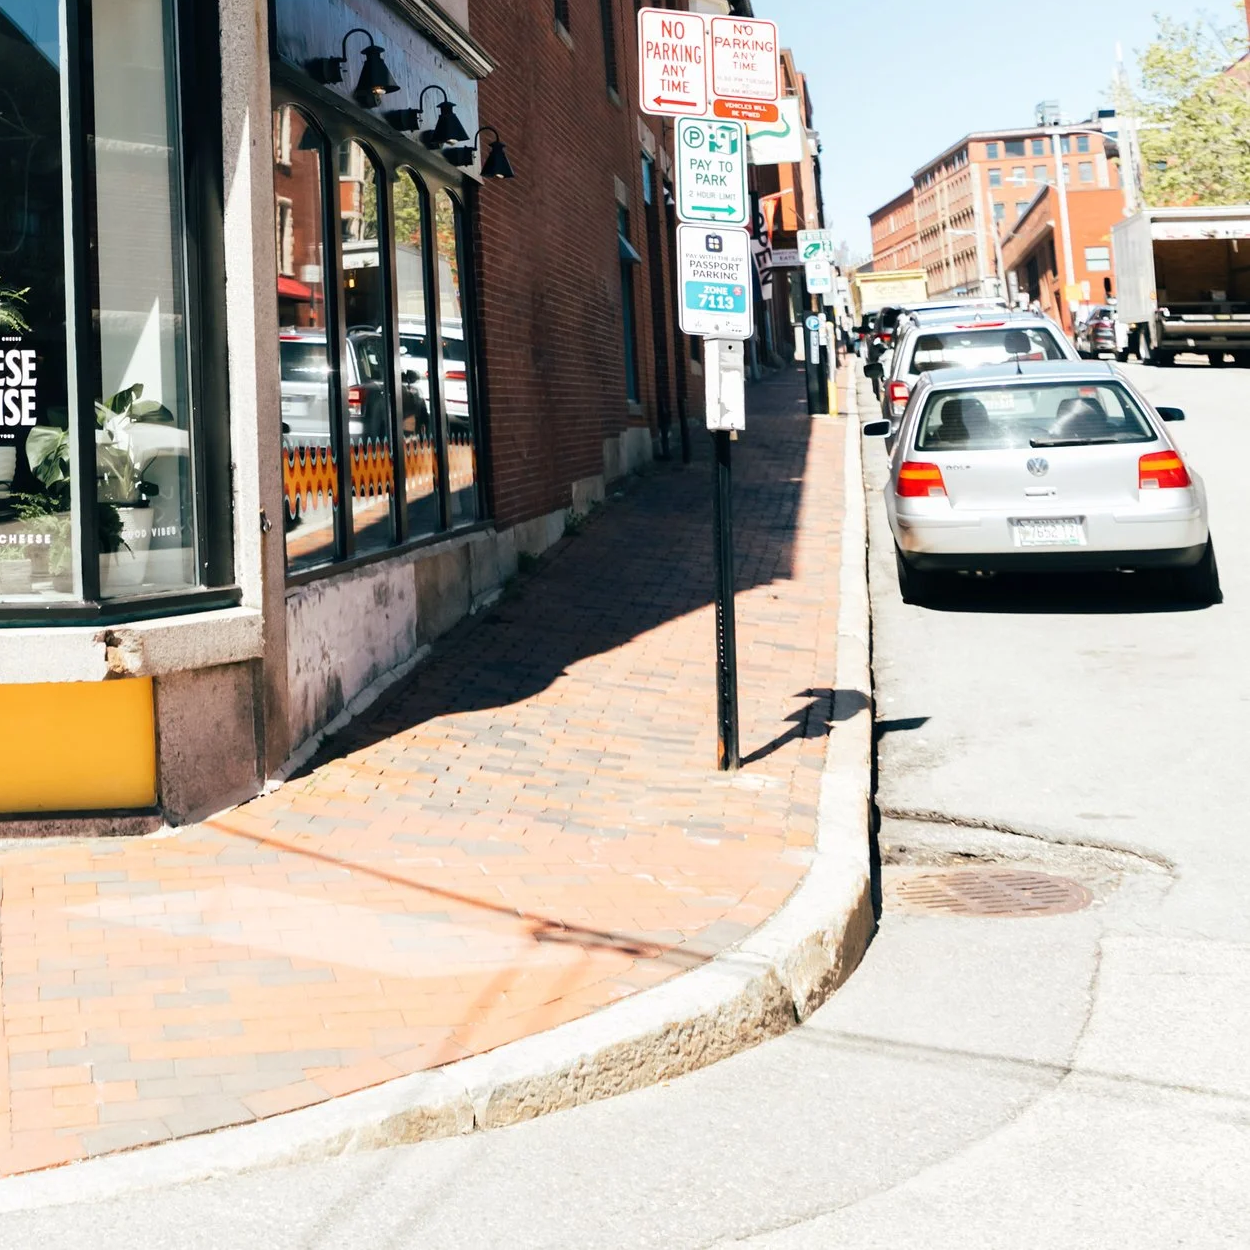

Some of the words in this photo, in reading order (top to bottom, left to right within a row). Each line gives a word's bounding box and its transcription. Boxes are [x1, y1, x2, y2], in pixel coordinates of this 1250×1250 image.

[661, 20, 685, 39] NO
[733, 24, 753, 36] NO
[715, 37, 773, 52] PARKING
[646, 41, 701, 64] PARKING
[733, 52, 756, 61] ANY
[662, 64, 686, 77] ANY
[733, 61, 757, 71] TIME
[660, 79, 690, 94] TIME
[690, 158, 712, 170] PAY
[718, 161, 733, 173] TO
[696, 173, 727, 186] PARK
[719, 193, 736, 201] LIMIT
[689, 260, 740, 271] PASSPORT
[693, 270, 738, 280] PARKING
[703, 285, 728, 295] ZONE
[698, 294, 734, 310] 7113
[152, 526, 176, 537] VIBES
